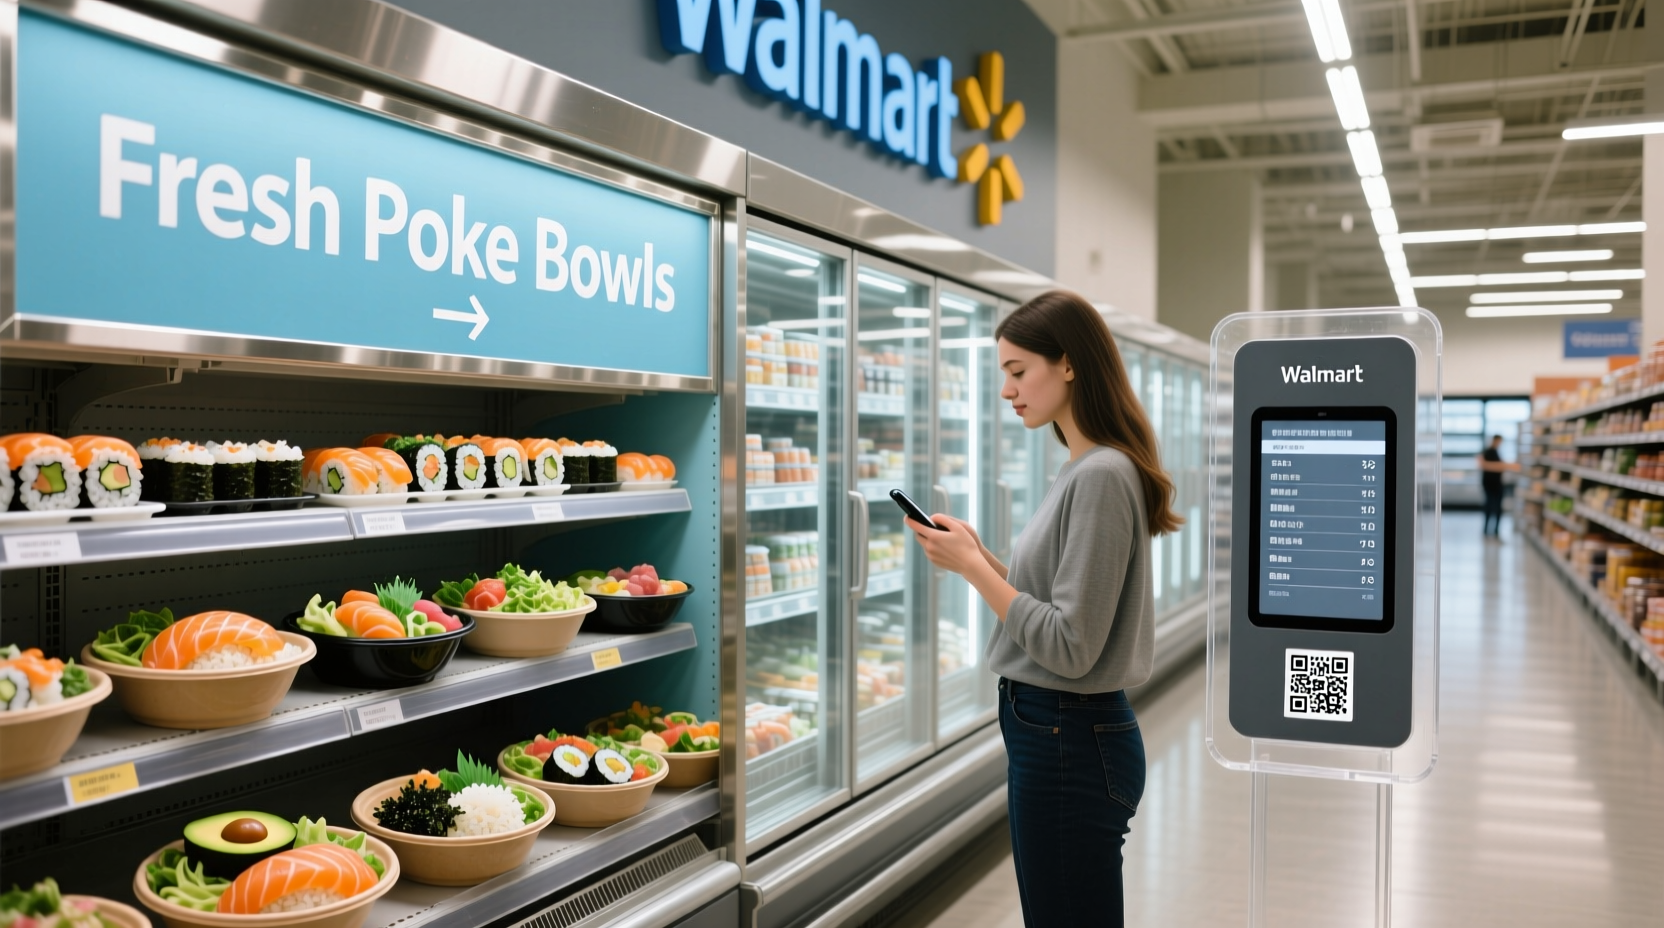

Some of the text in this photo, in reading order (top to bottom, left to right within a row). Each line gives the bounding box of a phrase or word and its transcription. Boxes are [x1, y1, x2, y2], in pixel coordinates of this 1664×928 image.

[100, 113, 676, 313] Fresh Poke Bowls
[1281, 365, 1363, 383] Walmart
